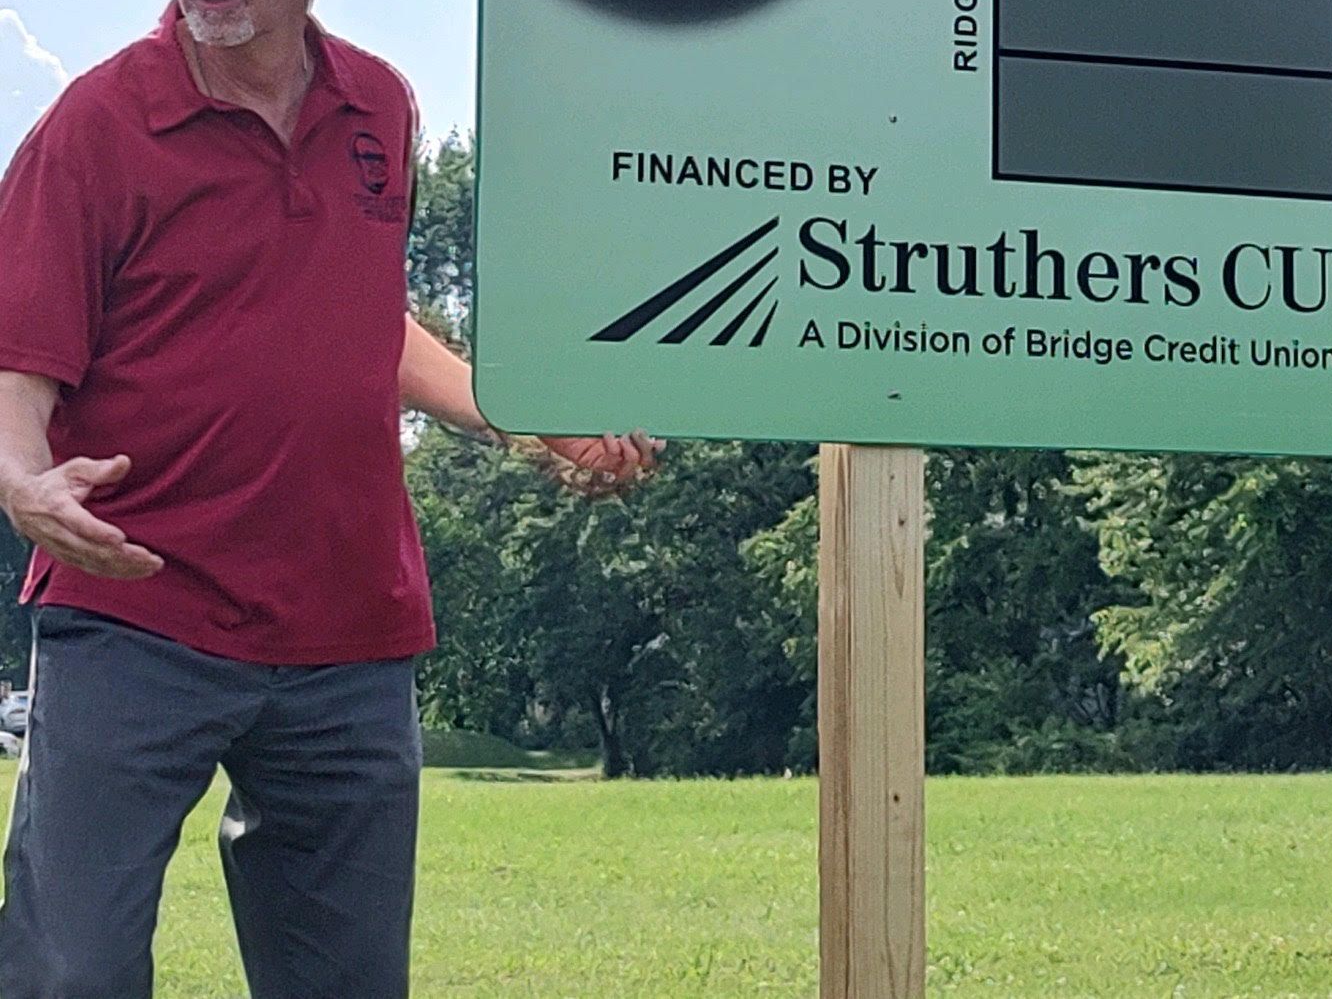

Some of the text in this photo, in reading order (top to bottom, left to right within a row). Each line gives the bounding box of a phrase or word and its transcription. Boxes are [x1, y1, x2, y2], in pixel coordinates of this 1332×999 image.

[612, 151, 878, 195] FINANCED BY
[798, 216, 1201, 307] Struthers
[798, 319, 825, 349] A
[837, 320, 970, 356] Division
[981, 326, 1016, 356] of
[1026, 328, 1134, 365] Bridge
[1144, 334, 1241, 366] Credit
